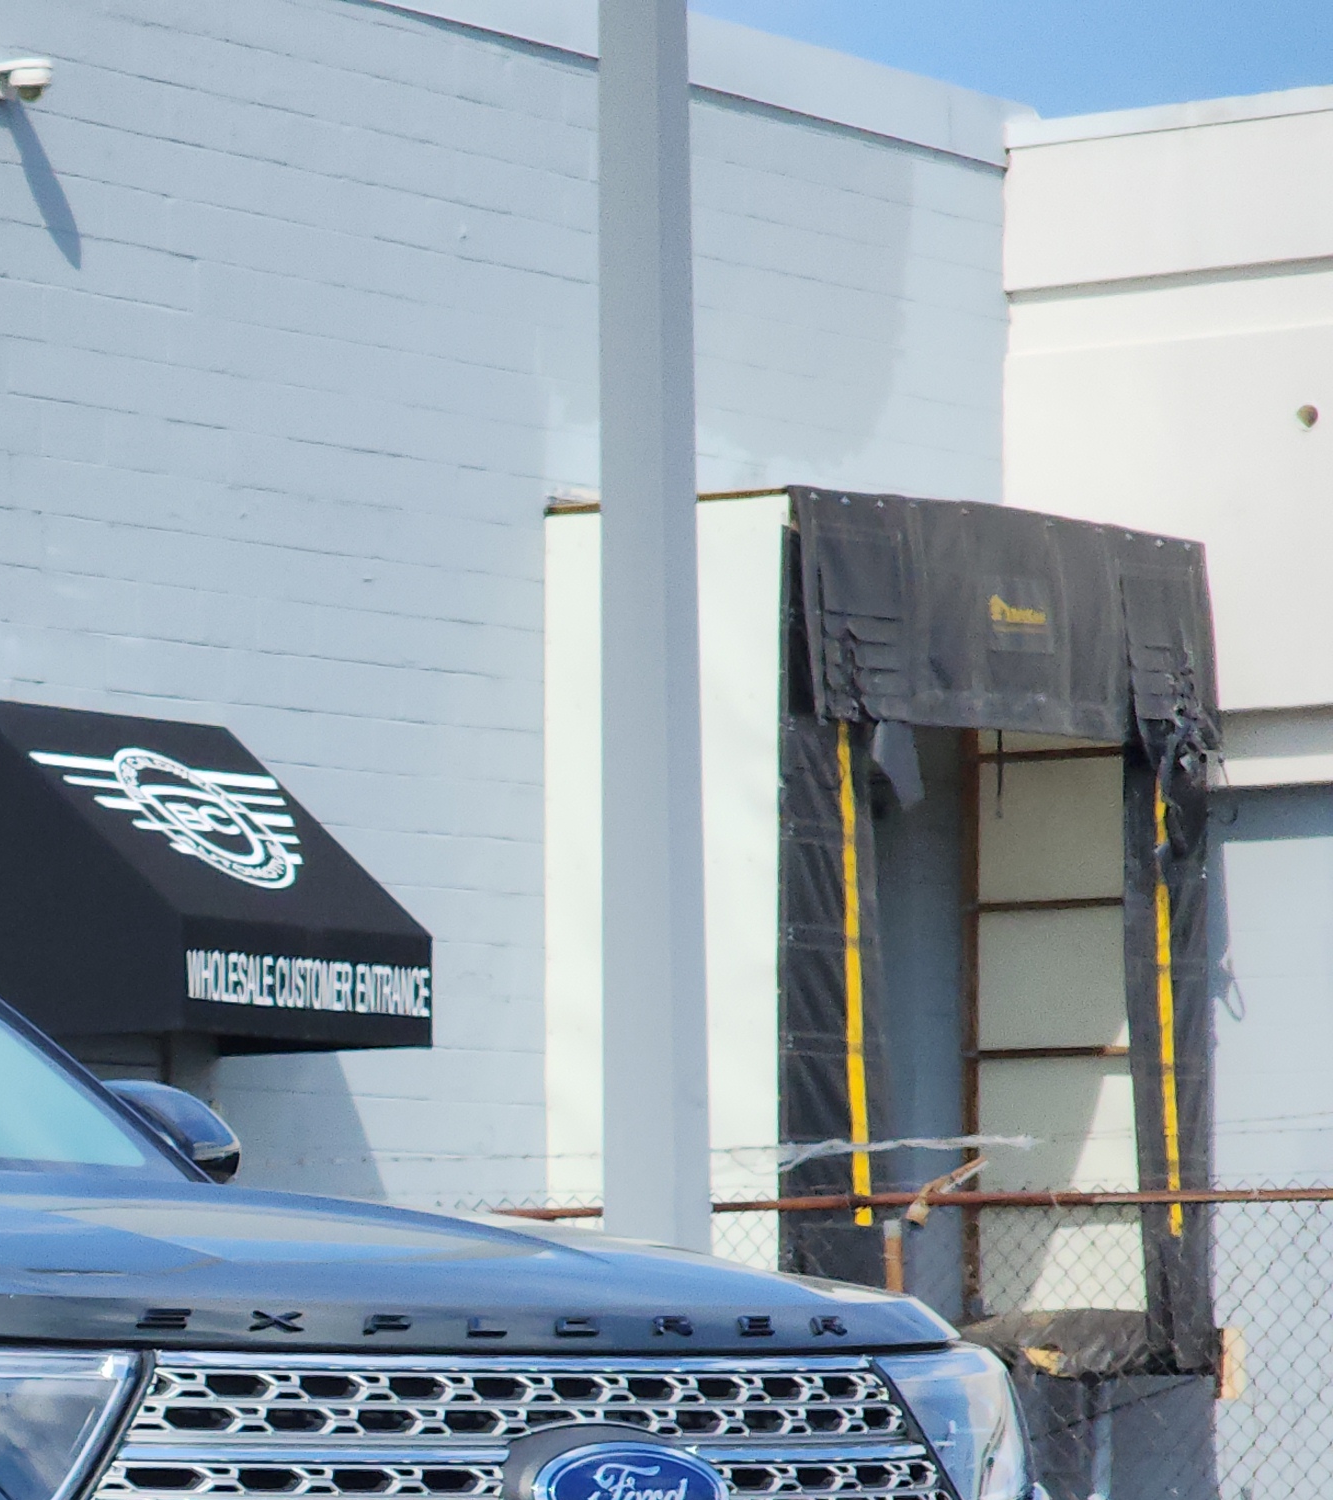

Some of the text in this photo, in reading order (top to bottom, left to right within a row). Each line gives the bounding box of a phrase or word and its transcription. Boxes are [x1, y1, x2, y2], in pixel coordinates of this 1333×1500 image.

[165, 802, 241, 835] BC
[186, 949, 430, 1018] WHOLESALE CUSTOMER ENTRANCE
[136, 1307, 848, 1339] EXPLORER
